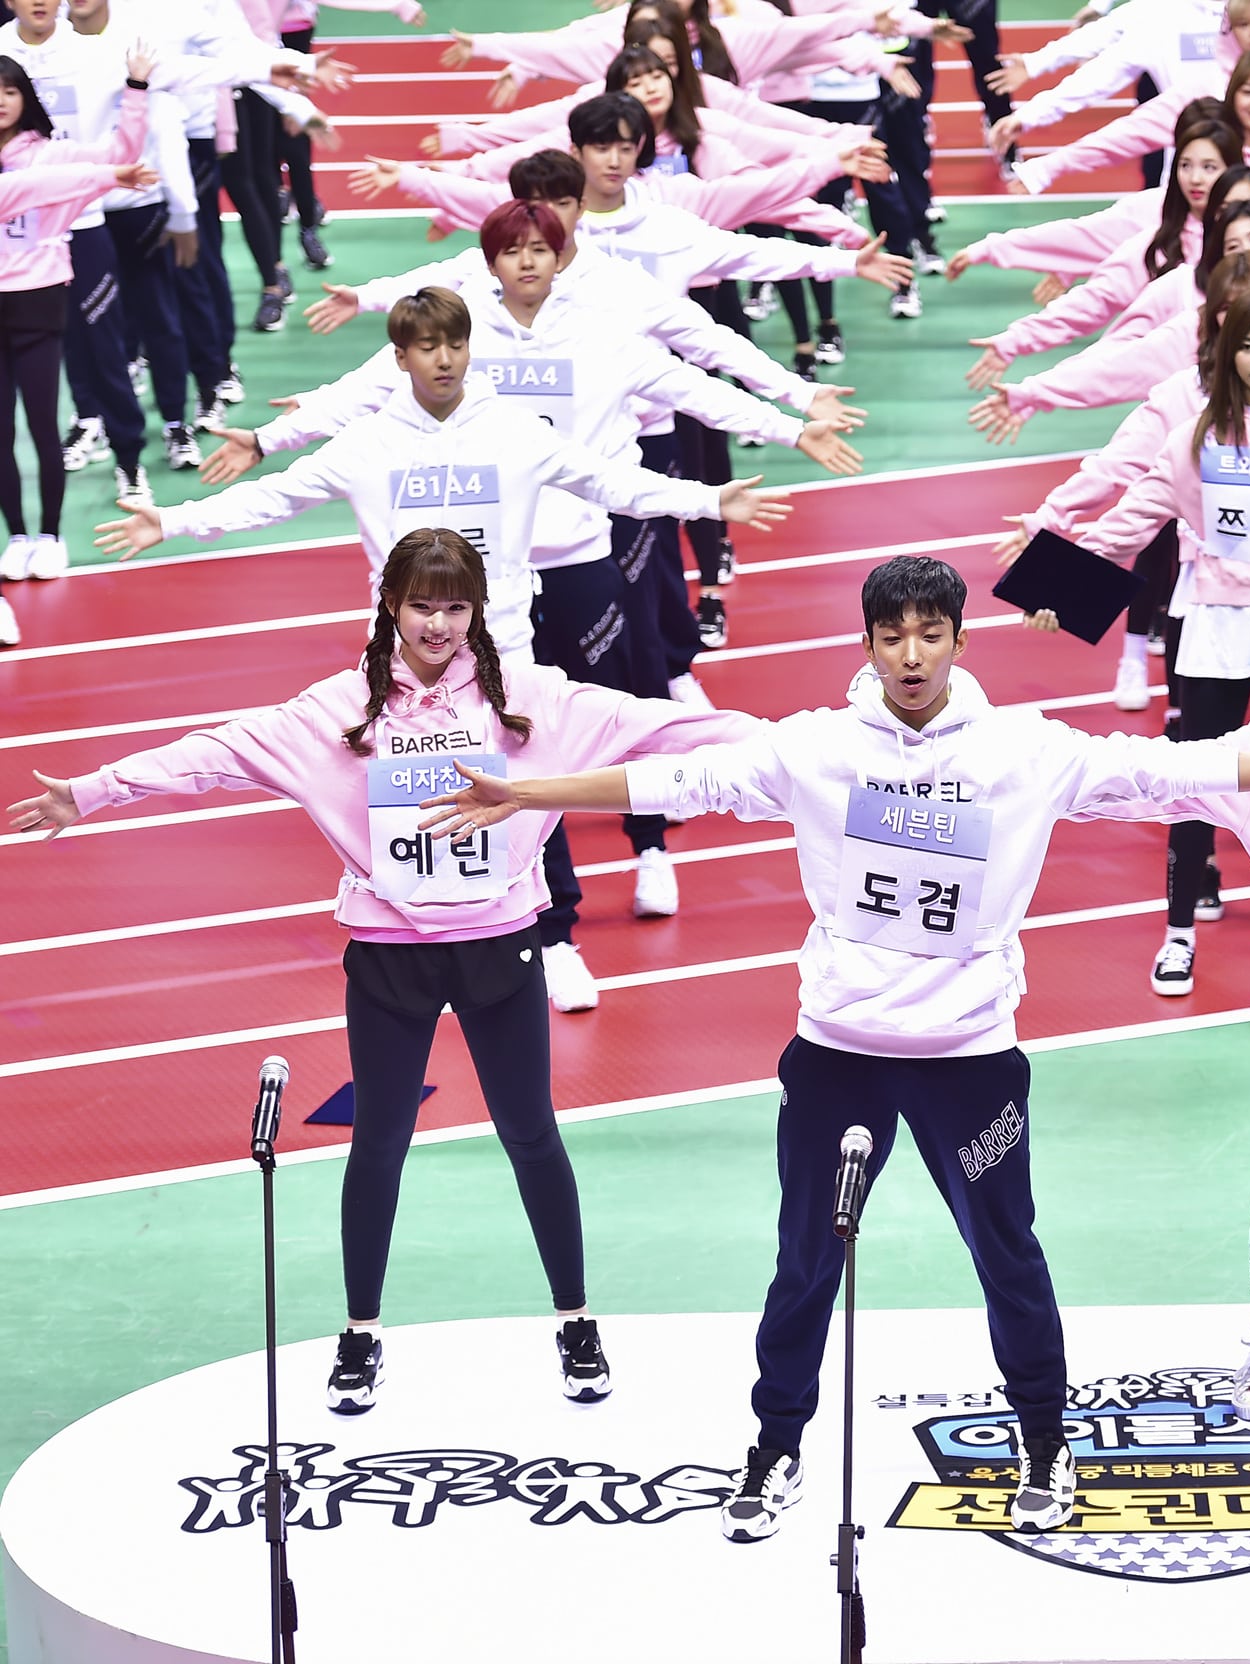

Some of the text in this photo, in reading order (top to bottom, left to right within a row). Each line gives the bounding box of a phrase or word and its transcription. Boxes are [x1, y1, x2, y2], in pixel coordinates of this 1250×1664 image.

[487, 364, 559, 387] B1A4
[407, 472, 484, 499] B1A4
[391, 729, 482, 754] BARREL
[880, 805, 957, 844] 세븐틴
[957, 1100, 1025, 1182] BARREL
[871, 1391, 993, 1409] 설특집
[1111, 1462, 1240, 1479] 리듬체조
